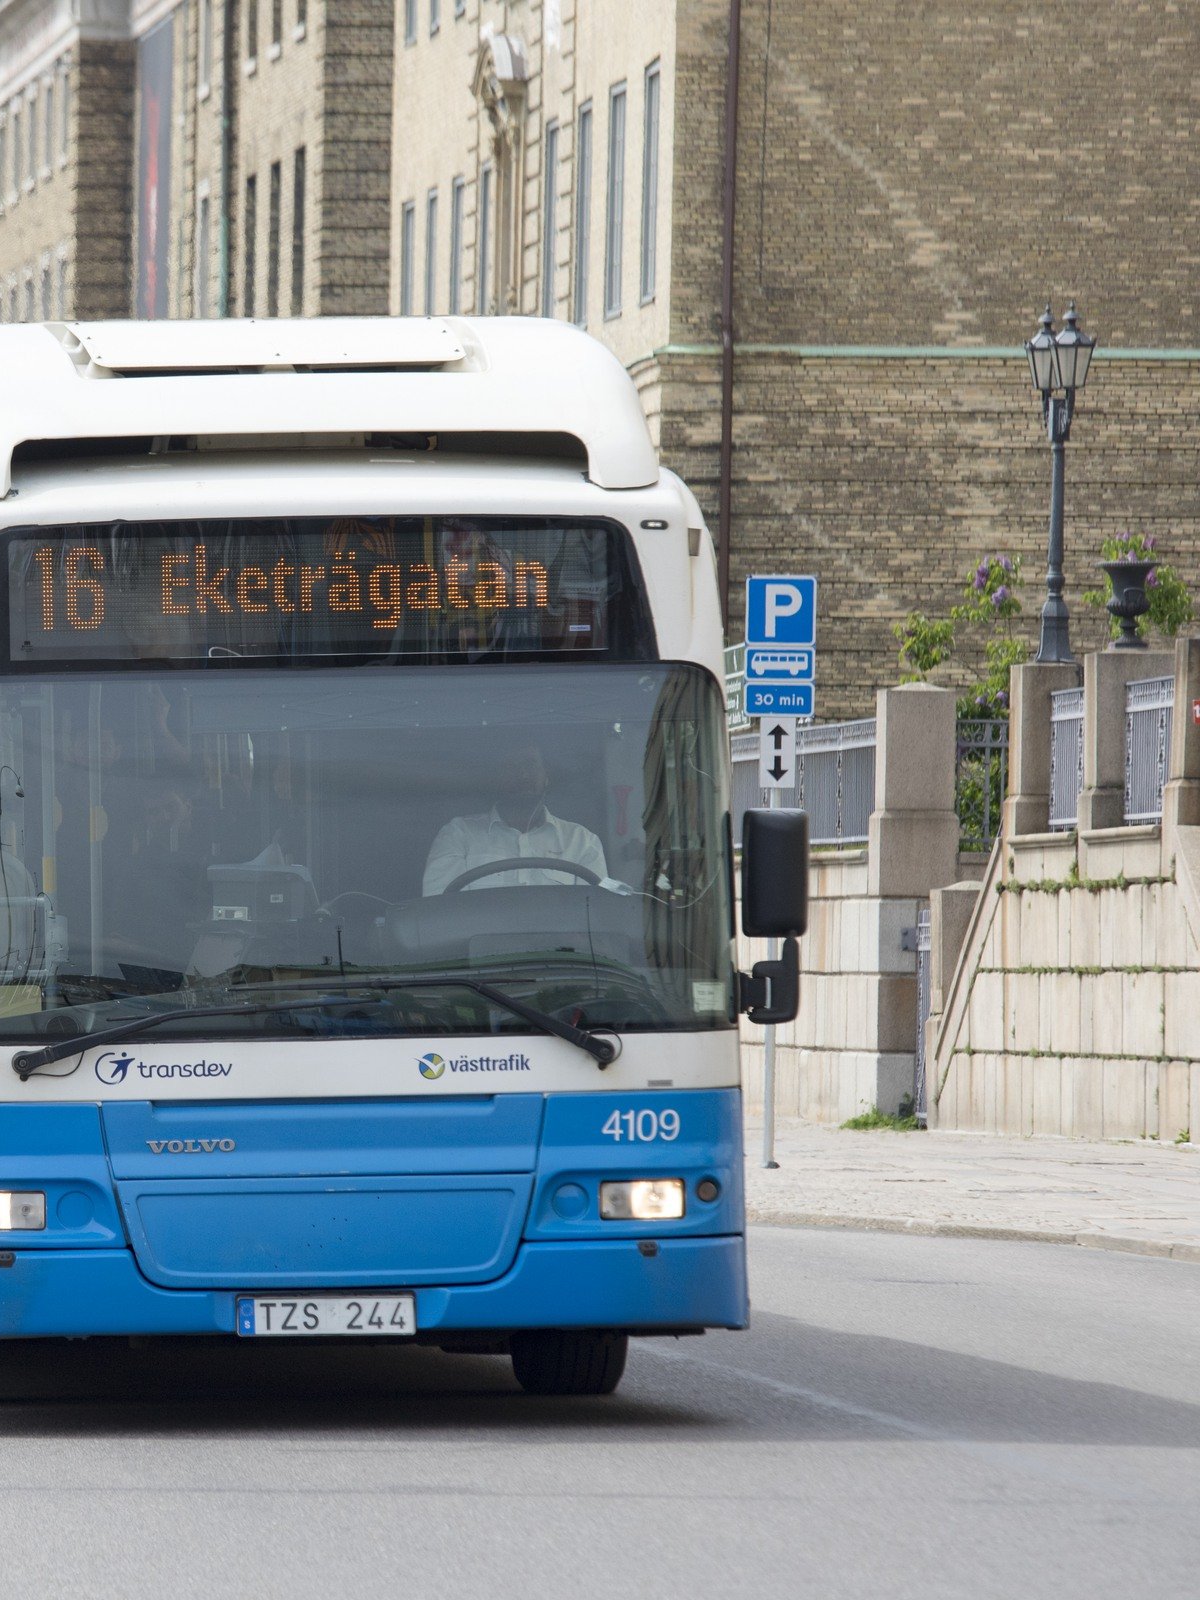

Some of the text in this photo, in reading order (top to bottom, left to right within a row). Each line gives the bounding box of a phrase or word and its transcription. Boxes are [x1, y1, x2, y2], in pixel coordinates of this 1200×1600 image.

[35, 544, 549, 632] 16 Eketrägatan
[764, 583, 803, 638] P
[754, 693, 775, 706] 30
[779, 693, 804, 706] min
[137, 1059, 233, 1078] transdev
[449, 1054, 531, 1073] västtrafik
[602, 1109, 681, 1142] 4109
[146, 1138, 236, 1154] VOLVO
[259, 1302, 406, 1330] TZS 244
